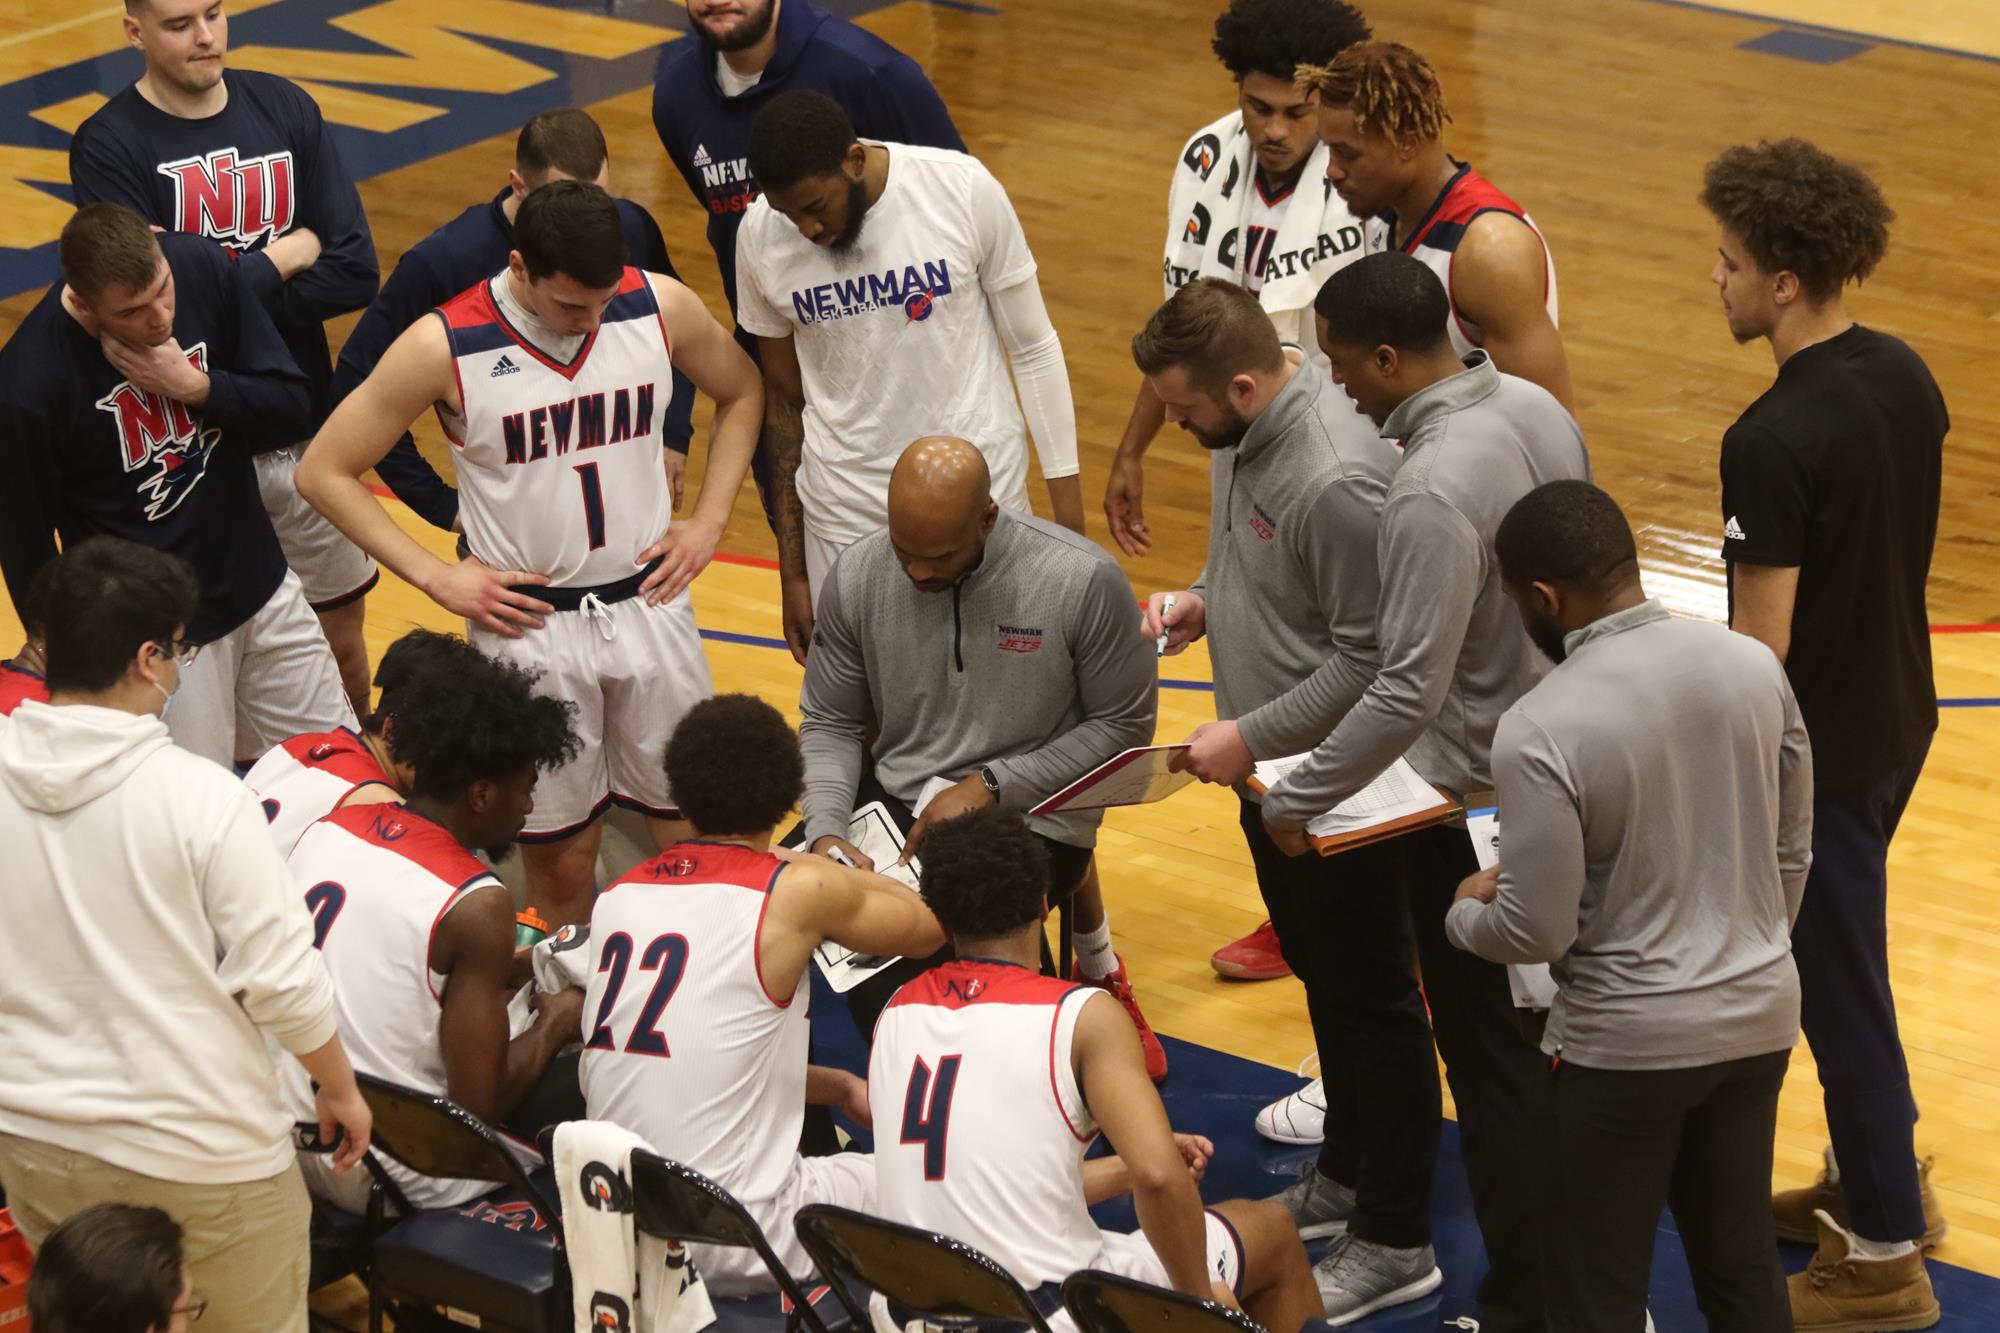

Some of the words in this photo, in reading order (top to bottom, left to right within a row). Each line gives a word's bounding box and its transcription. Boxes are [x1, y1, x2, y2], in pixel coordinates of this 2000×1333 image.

[157, 146, 295, 243] NU
[792, 259, 953, 326] NEWMAN
[803, 297, 893, 325] BASKETBALL
[491, 364, 521, 378] adidas
[502, 383, 655, 465] NEWMAN
[572, 461, 607, 552] 1
[998, 624, 1043, 636] NEWMAN
[585, 931, 690, 1058] 22
[900, 1053, 963, 1181] 4
